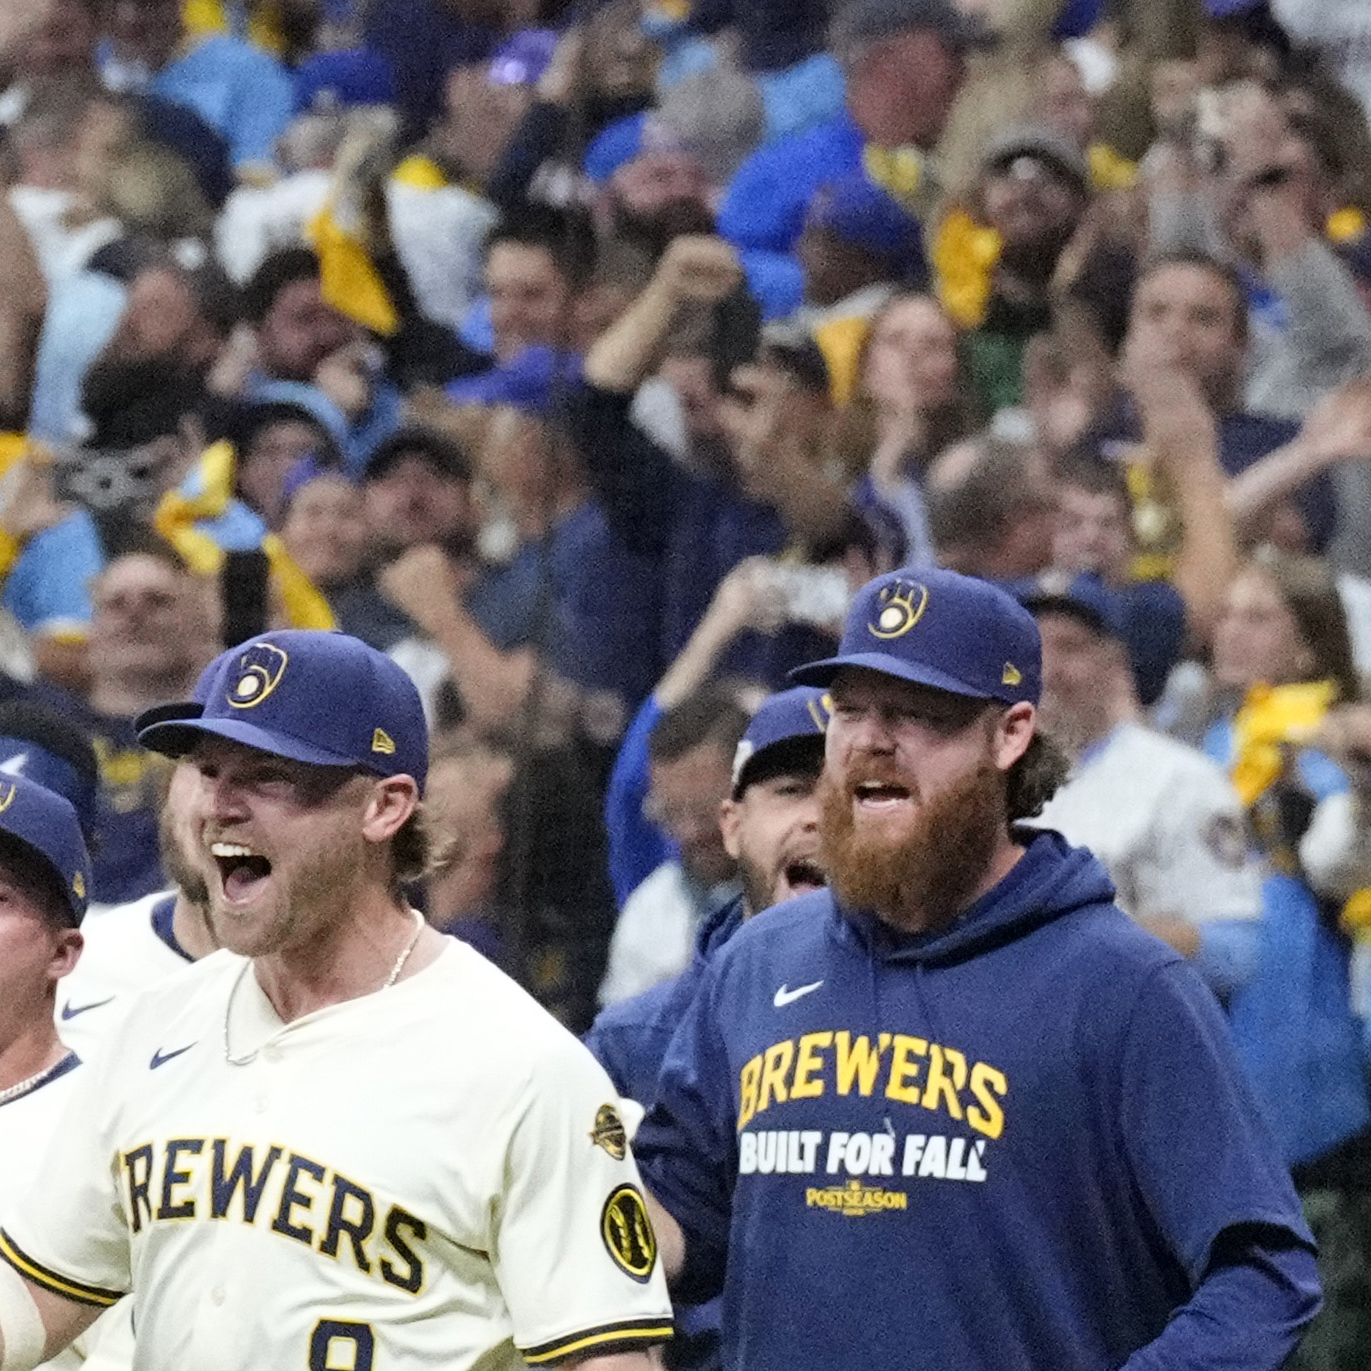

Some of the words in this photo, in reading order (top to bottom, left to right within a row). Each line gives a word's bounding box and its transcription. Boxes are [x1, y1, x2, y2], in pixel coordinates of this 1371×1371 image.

[737, 1029, 1008, 1140] BREWERS
[739, 1131, 822, 1175] BUILT
[825, 1131, 895, 1176] FOR
[901, 1133, 988, 1183] FALL
[806, 1187, 908, 1210] POSTSEASON
